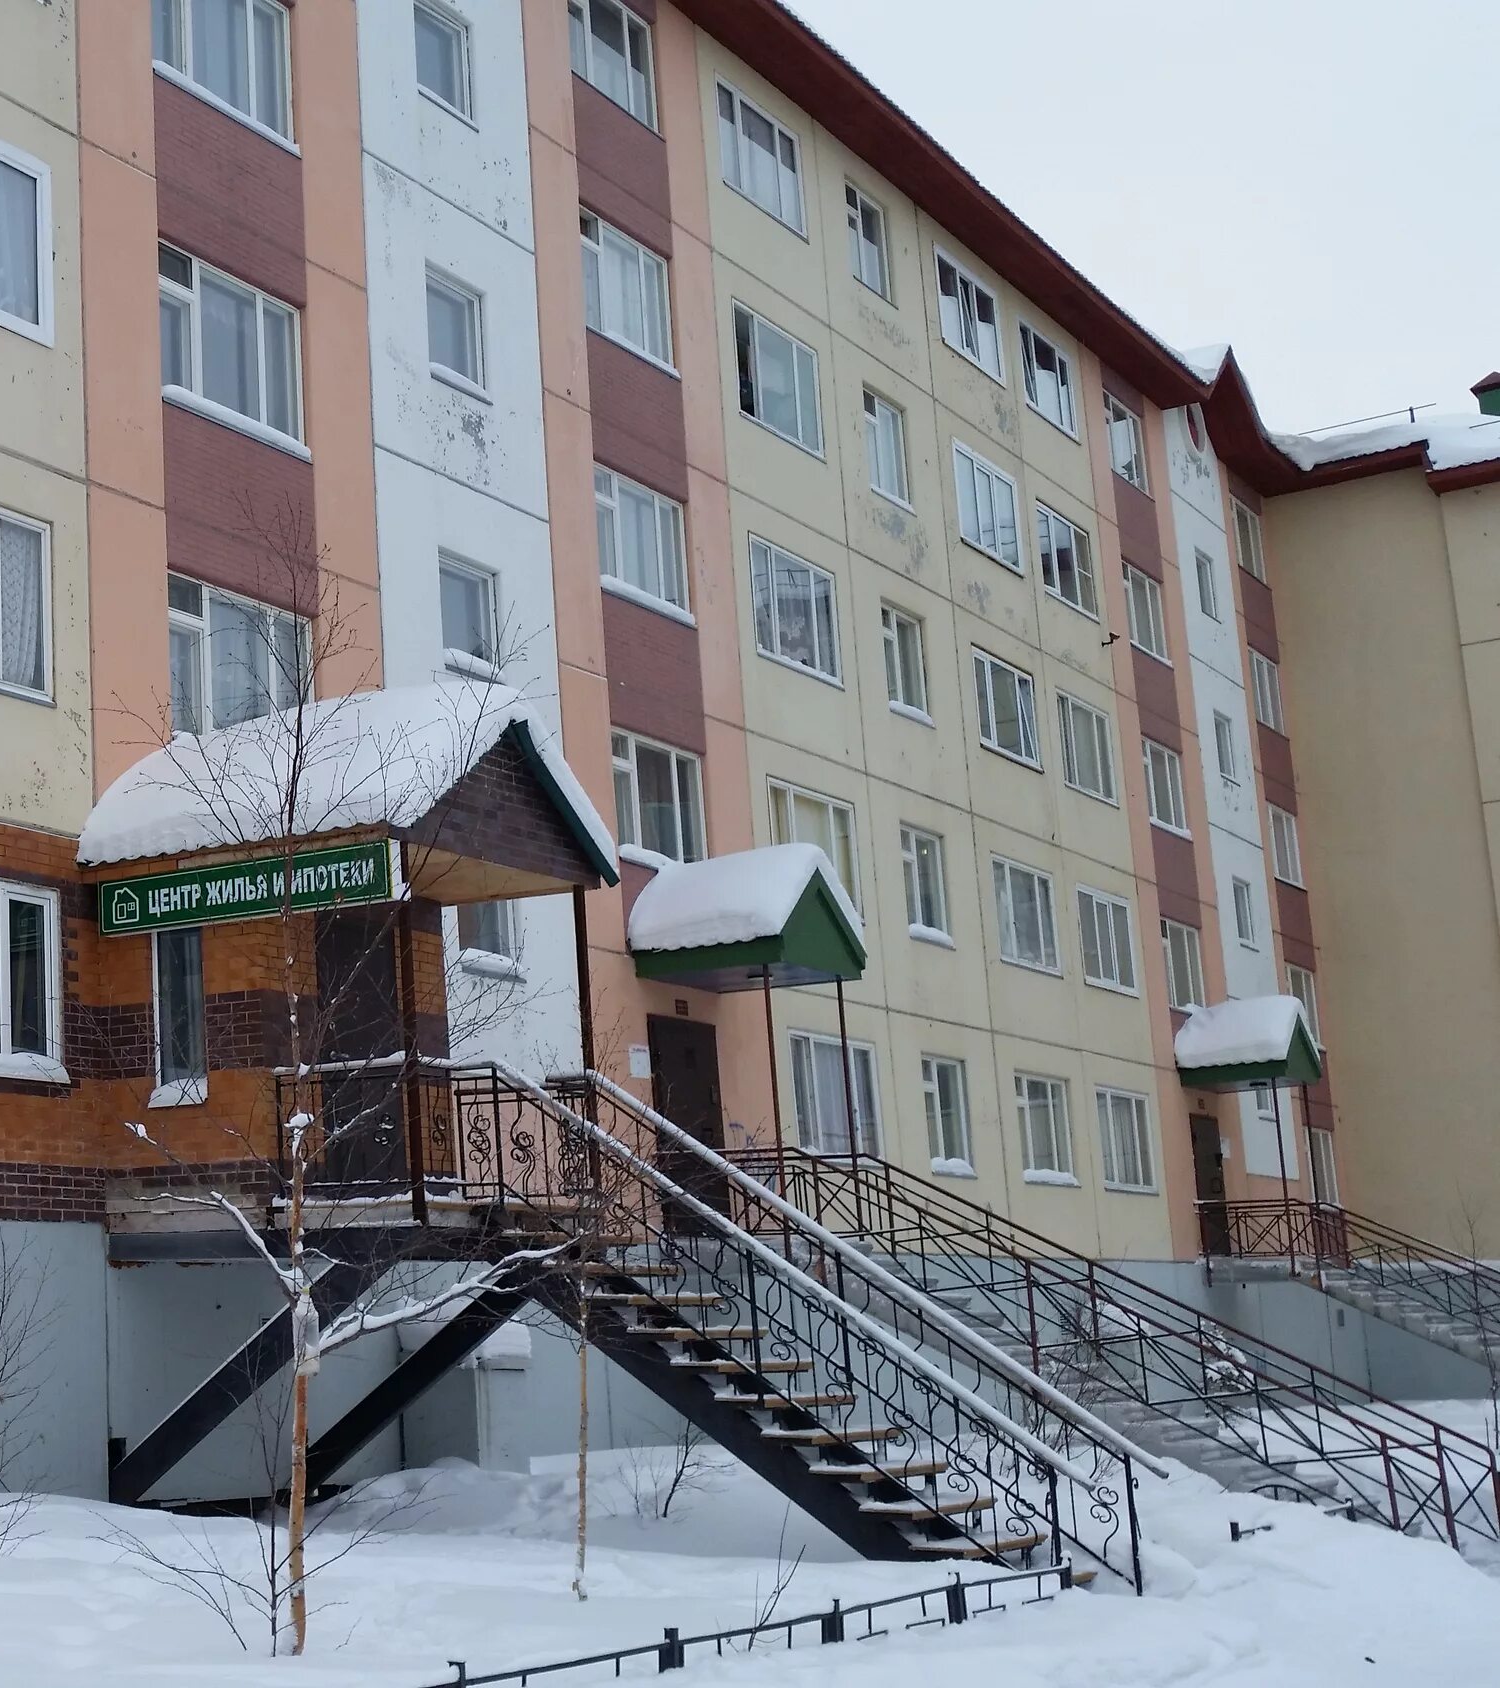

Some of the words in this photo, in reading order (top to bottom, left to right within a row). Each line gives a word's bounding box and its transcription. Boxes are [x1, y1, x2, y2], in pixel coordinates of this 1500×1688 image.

[148, 883, 201, 918] ЦЕНТР
[206, 873, 268, 906] ЖИЛЬЯ
[273, 871, 286, 897] И
[290, 858, 375, 895] ИПОТЕКИ
